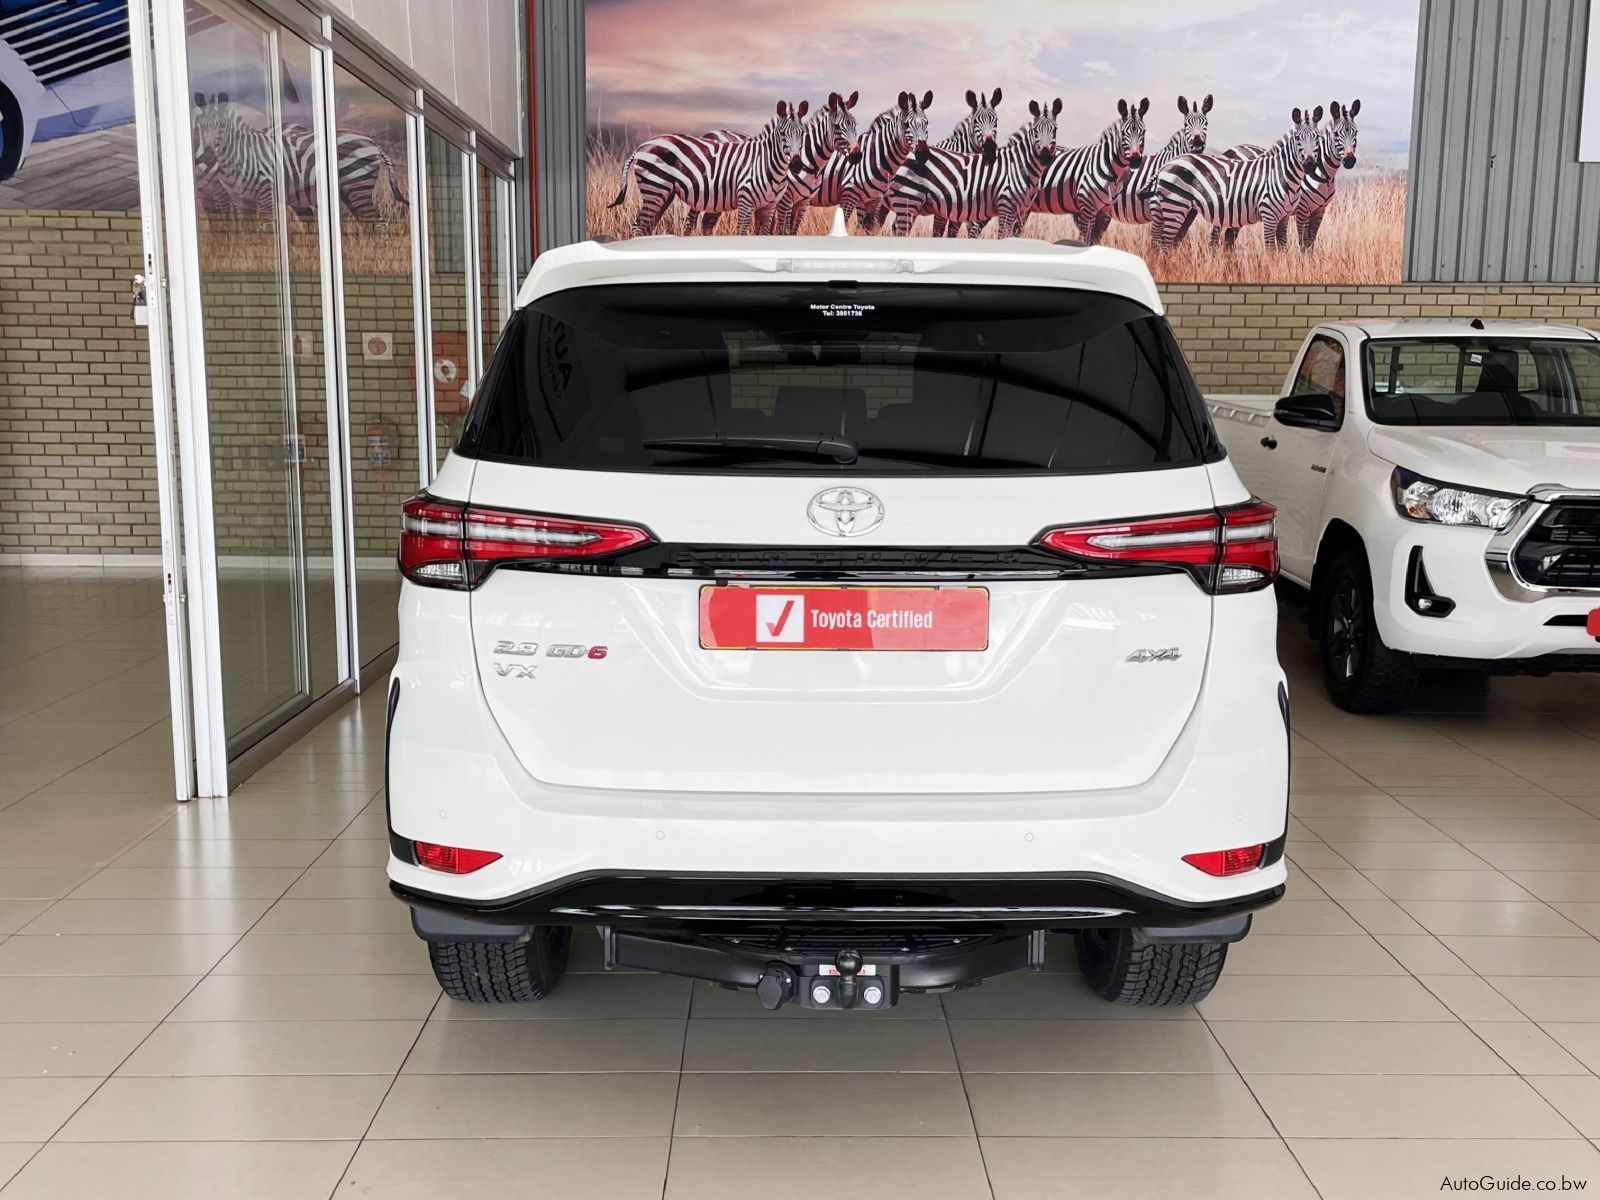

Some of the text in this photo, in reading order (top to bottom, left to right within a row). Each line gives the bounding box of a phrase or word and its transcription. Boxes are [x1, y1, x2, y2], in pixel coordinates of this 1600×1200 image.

[811, 609, 933, 630] Toyota Certified
[493, 662, 538, 679] VX
